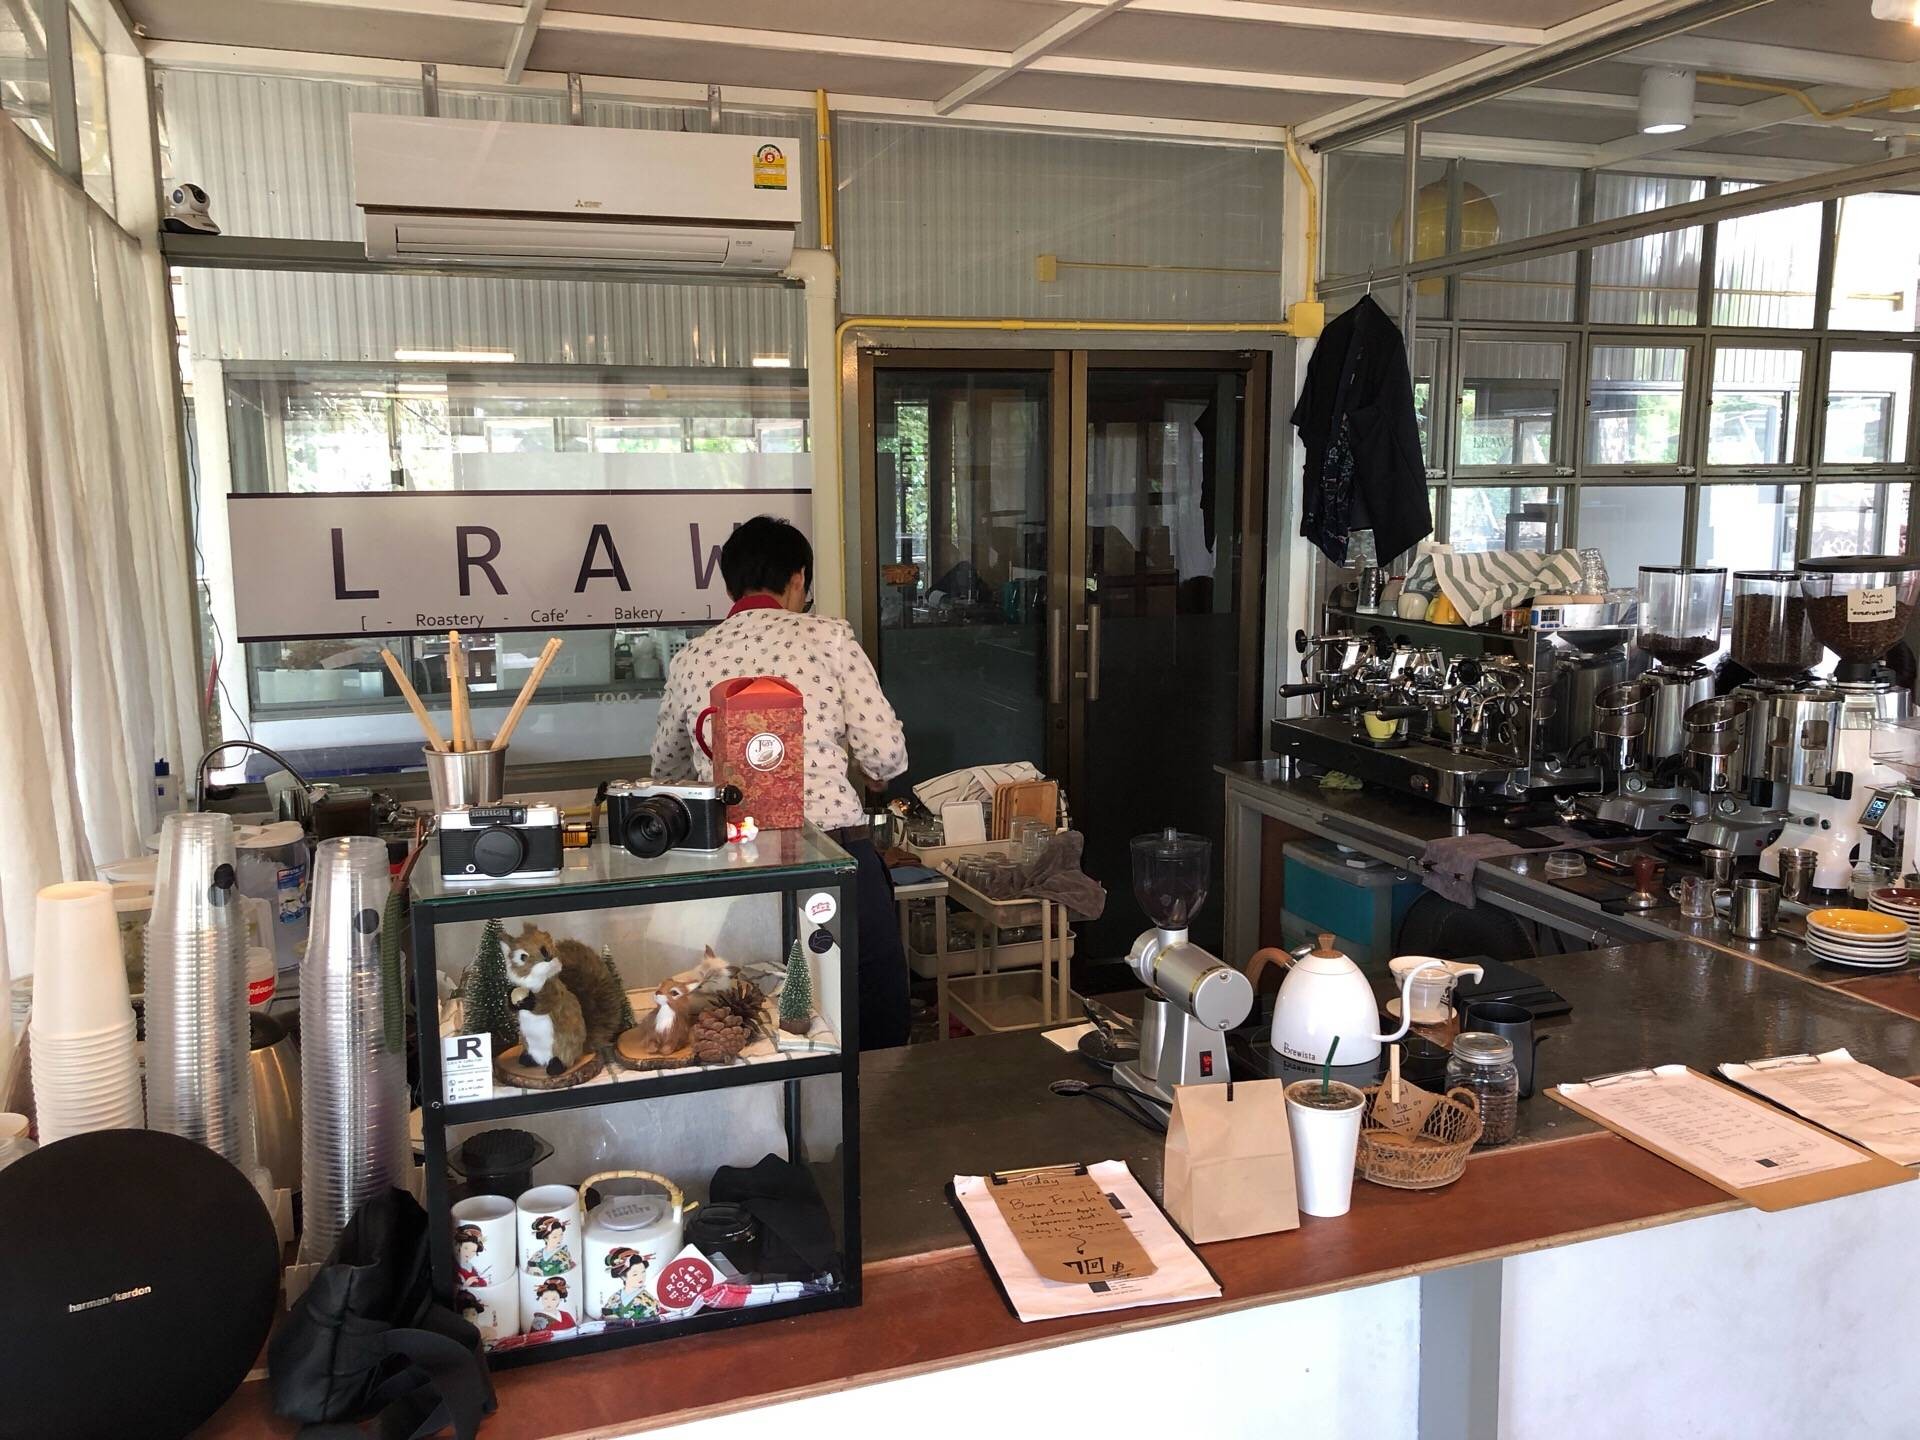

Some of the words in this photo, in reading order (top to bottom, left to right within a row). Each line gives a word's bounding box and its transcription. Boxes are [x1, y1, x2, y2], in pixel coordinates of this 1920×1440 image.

[416, 613, 484, 628] Roastery
[615, 606, 663, 623] Bakery
[1283, 1041, 1316, 1060] Brewista
[1020, 1175, 1060, 1188] Today
[69, 1286, 152, 1312] harman/kardon
